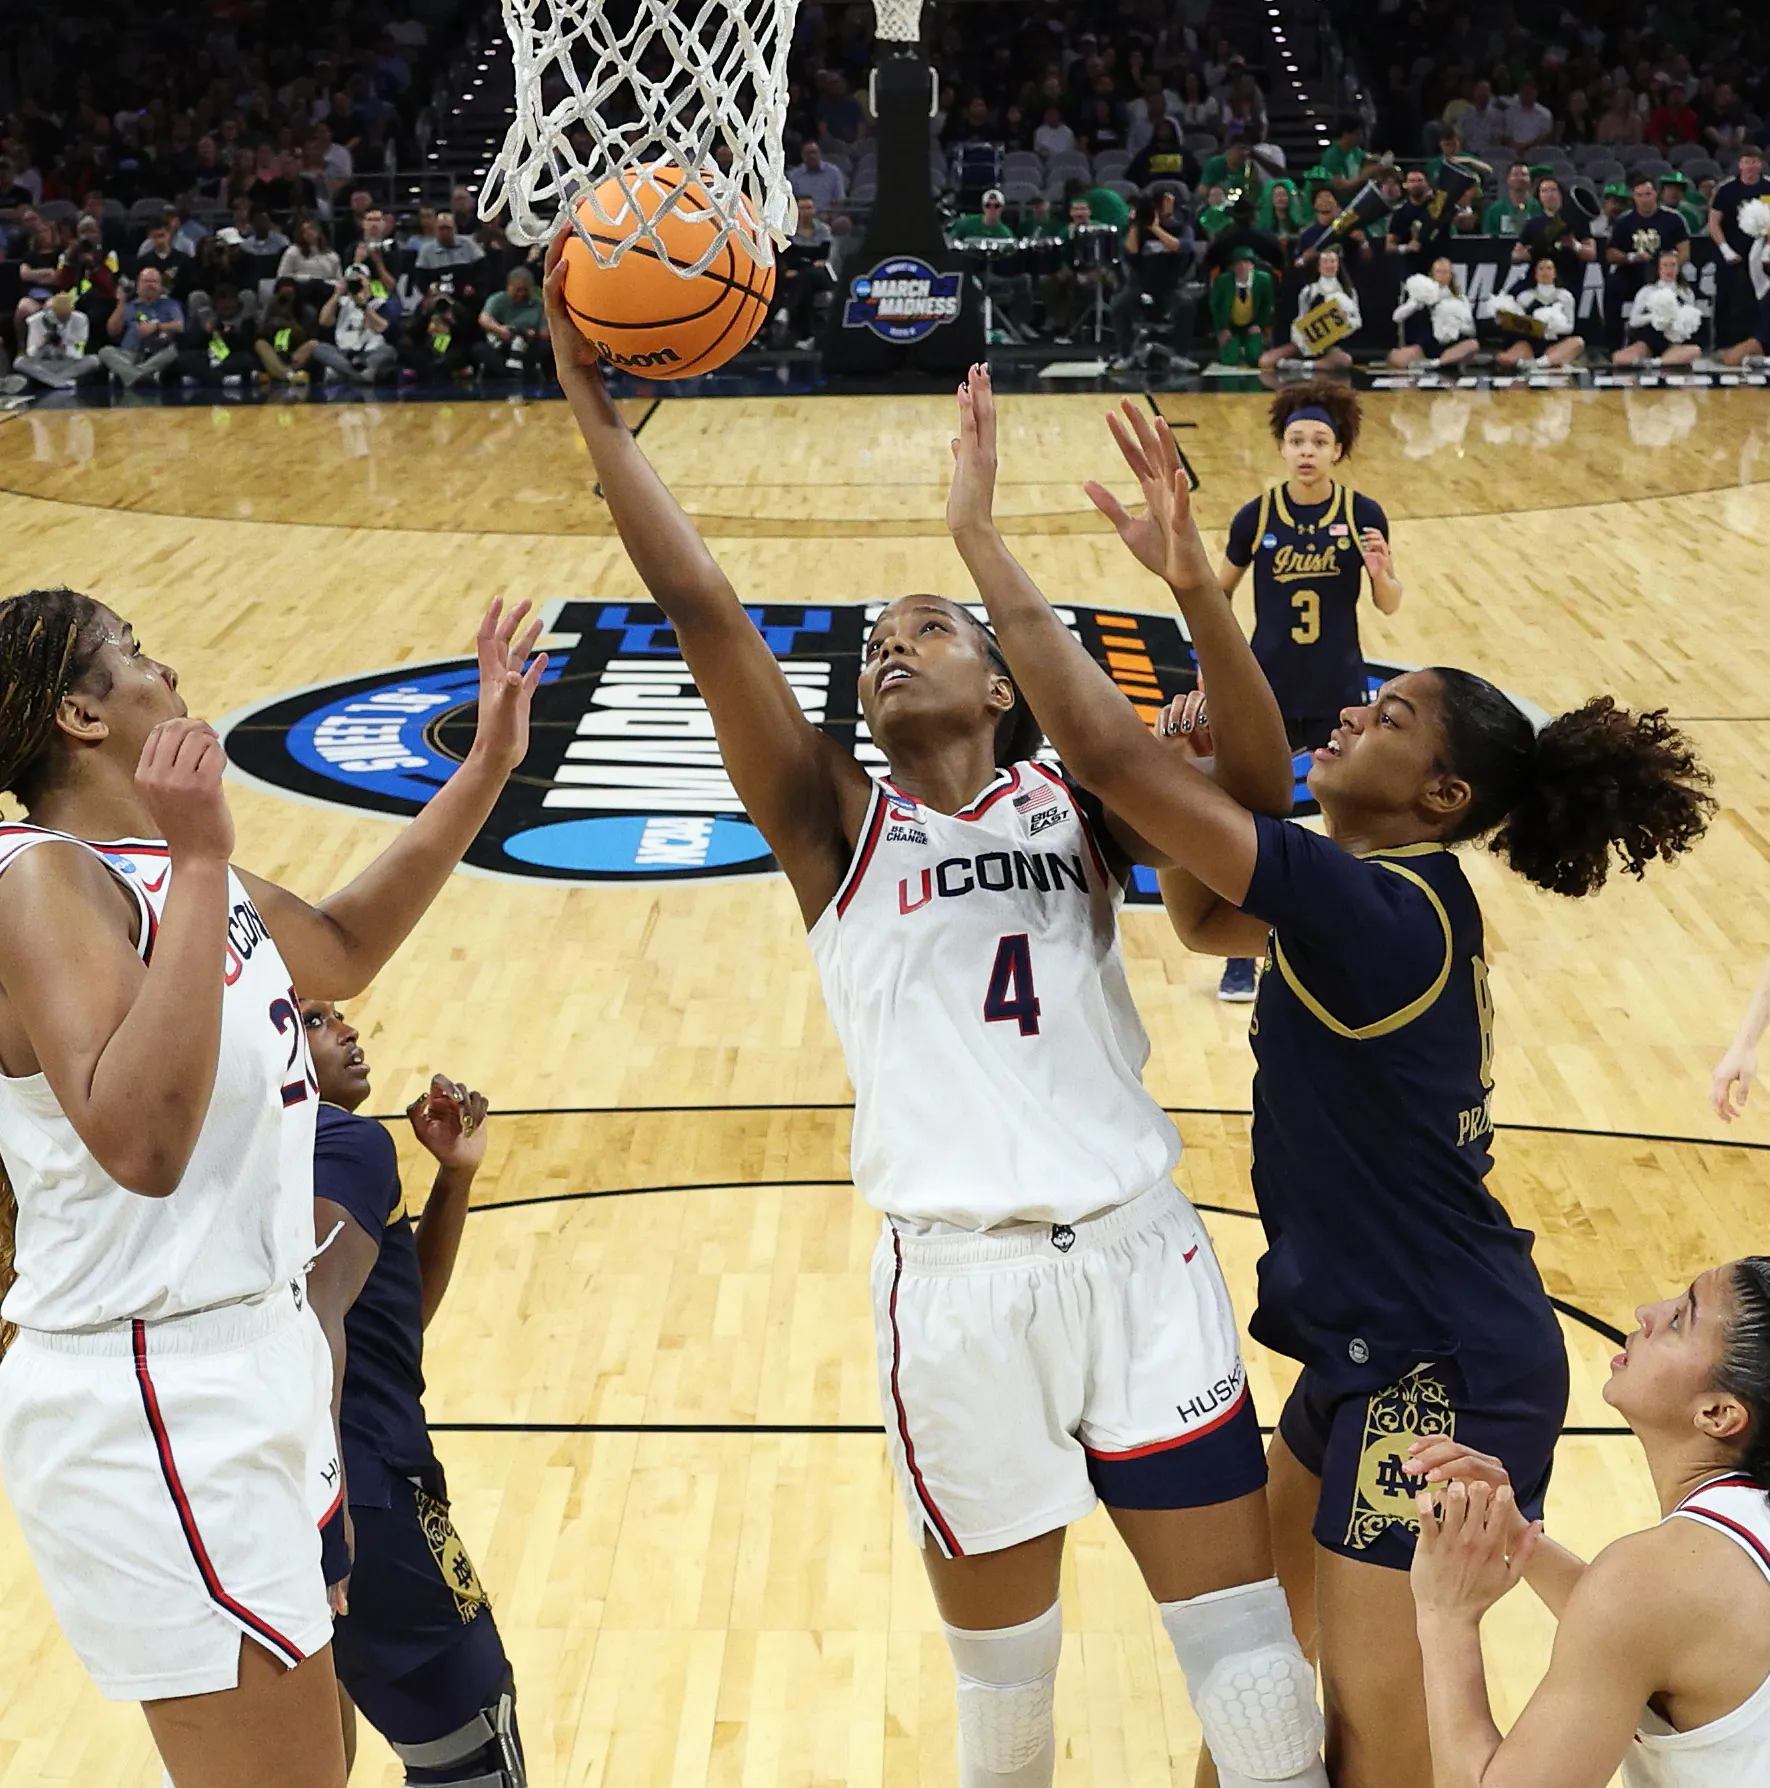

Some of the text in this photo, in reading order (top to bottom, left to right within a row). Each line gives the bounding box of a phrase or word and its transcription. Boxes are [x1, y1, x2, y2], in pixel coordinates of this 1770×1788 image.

[871, 280, 931, 298] MARCH
[878, 297, 957, 316] MADNESS
[1304, 307, 1344, 343] LET'S
[591, 340, 683, 367] lson
[1272, 544, 1341, 581] Irish
[1291, 589, 1321, 645] 3
[313, 715, 429, 772] SWEET
[891, 825, 905, 834] BE
[1030, 809, 1069, 832] EAST
[1031, 806, 1058, 824] BIG
[634, 816, 716, 866] NCAA
[886, 832, 928, 845] CHANGE
[909, 828, 927, 837] THE
[898, 850, 1090, 915] UCONN
[223, 900, 272, 987] UCON
[983, 932, 1041, 1037] 4
